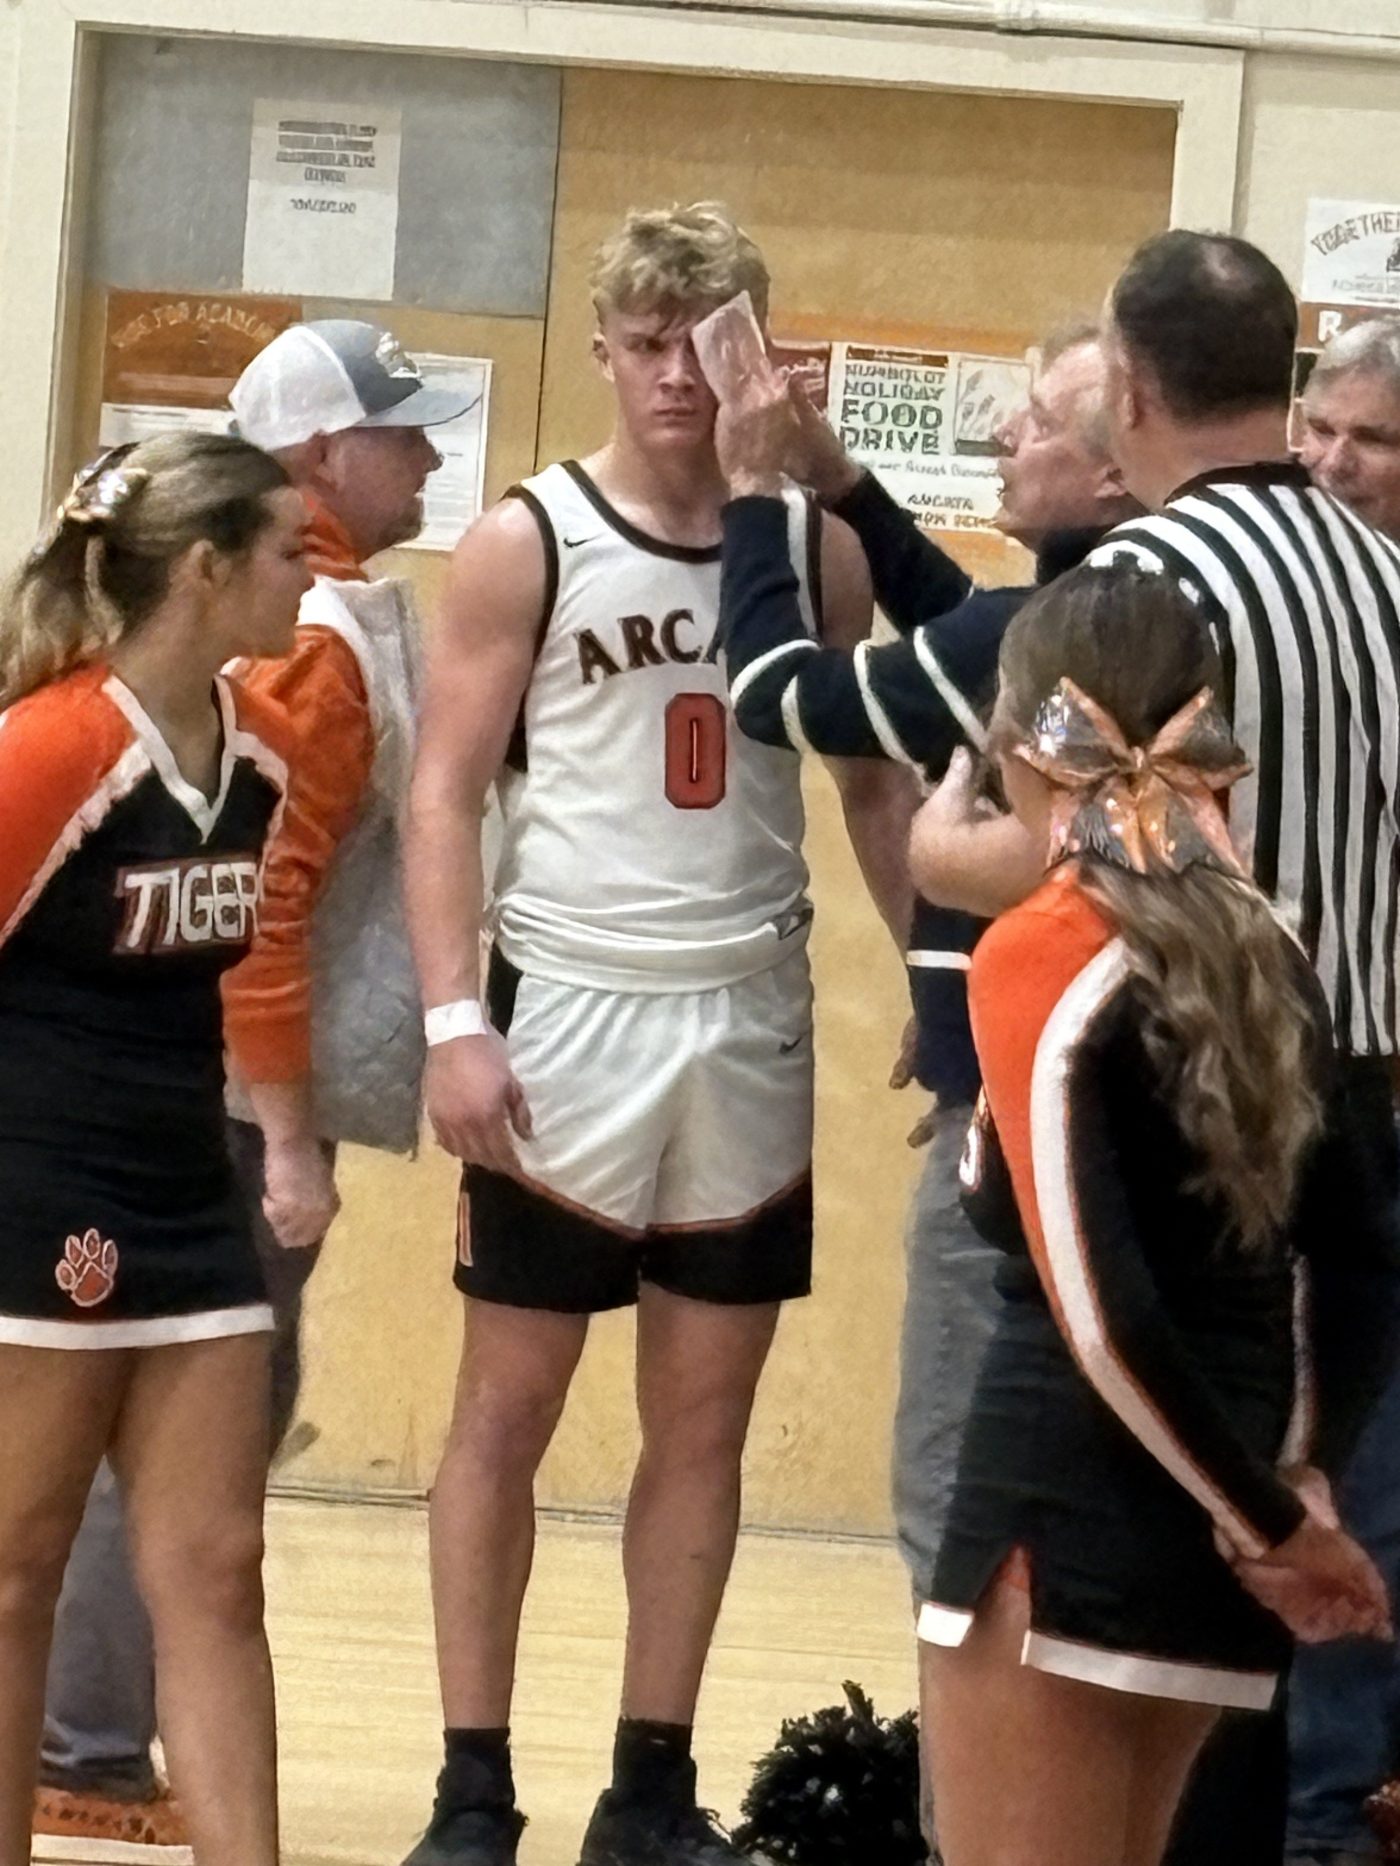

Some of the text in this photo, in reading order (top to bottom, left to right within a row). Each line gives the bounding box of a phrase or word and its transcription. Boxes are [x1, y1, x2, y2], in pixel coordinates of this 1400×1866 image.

[1310, 210, 1400, 256] TOGETHE
[841, 398, 943, 430] FOOD
[840, 426, 940, 455] DRIVE
[664, 692, 726, 810] 0
